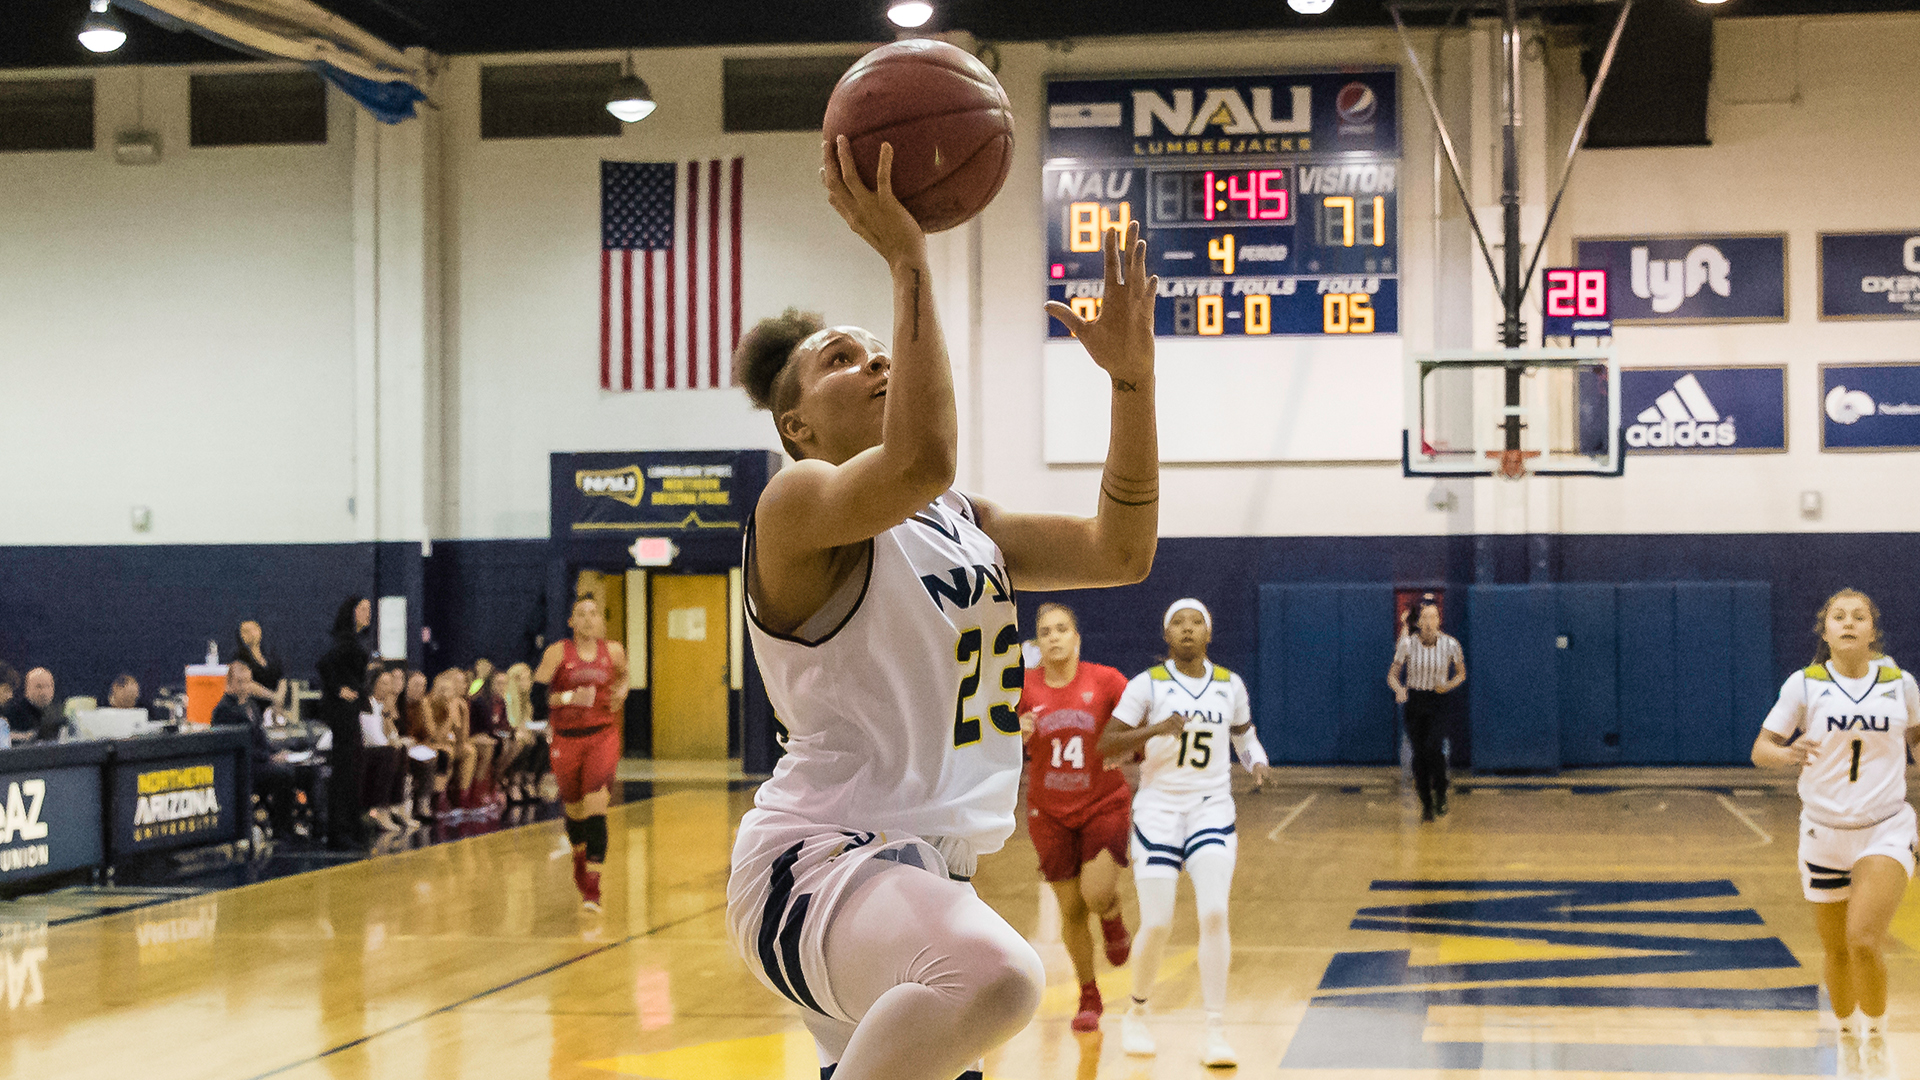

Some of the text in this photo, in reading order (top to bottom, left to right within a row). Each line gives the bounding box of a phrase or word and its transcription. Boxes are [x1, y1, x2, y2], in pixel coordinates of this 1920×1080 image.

[1131, 85, 1312, 137] NAU
[1134, 138, 1312, 155] LUMBERJACKS
[1057, 169, 1133, 199] NAU
[1204, 169, 1289, 221] 1:45
[1299, 165, 1396, 194] VISITOR
[1070, 202, 1131, 252] 84
[1323, 196, 1386, 247] 71
[1208, 234, 1235, 274] 4
[1064, 281, 1104, 299] FOU
[1156, 279, 1298, 297] LAYER FOULS
[1317, 278, 1381, 294] FOULS
[1547, 269, 1607, 317] 28
[1630, 243, 1731, 313] lyft
[1323, 293, 1376, 334] 05
[1625, 416, 1737, 447] adidas
[953, 623, 1025, 750] 23
[1827, 715, 1890, 732] NAU
[1050, 735, 1085, 769] 14
[1177, 731, 1213, 768] 15
[1849, 738, 1863, 783] 1
[134, 786, 219, 826] ARIZONA
